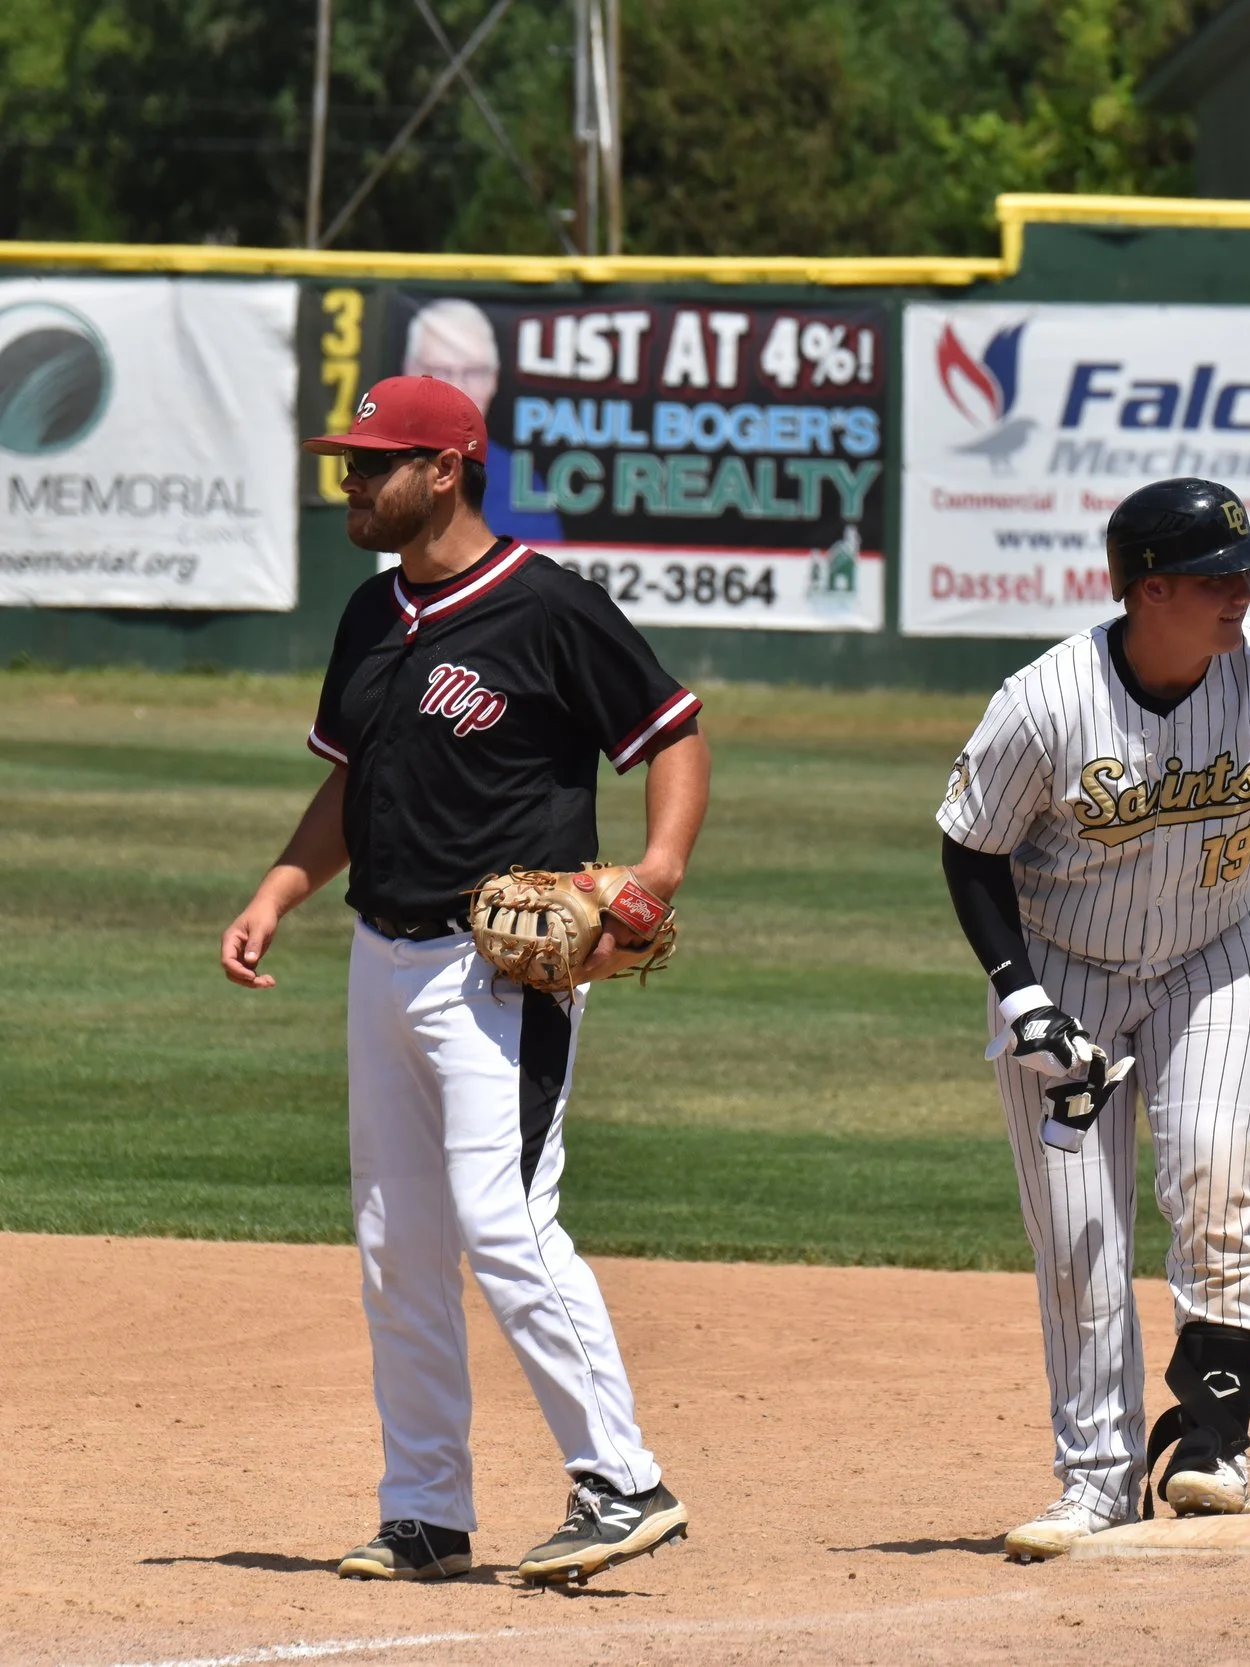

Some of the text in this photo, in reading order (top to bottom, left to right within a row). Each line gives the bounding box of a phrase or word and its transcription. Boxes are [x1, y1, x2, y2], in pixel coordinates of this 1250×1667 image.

[518, 310, 875, 389] LIST AT 4%!
[513, 397, 881, 455] PAUL BOGER'S
[9, 474, 261, 518] MEMORIAL
[510, 450, 883, 521] LC REALTY
[930, 563, 1055, 608] Dassel,
